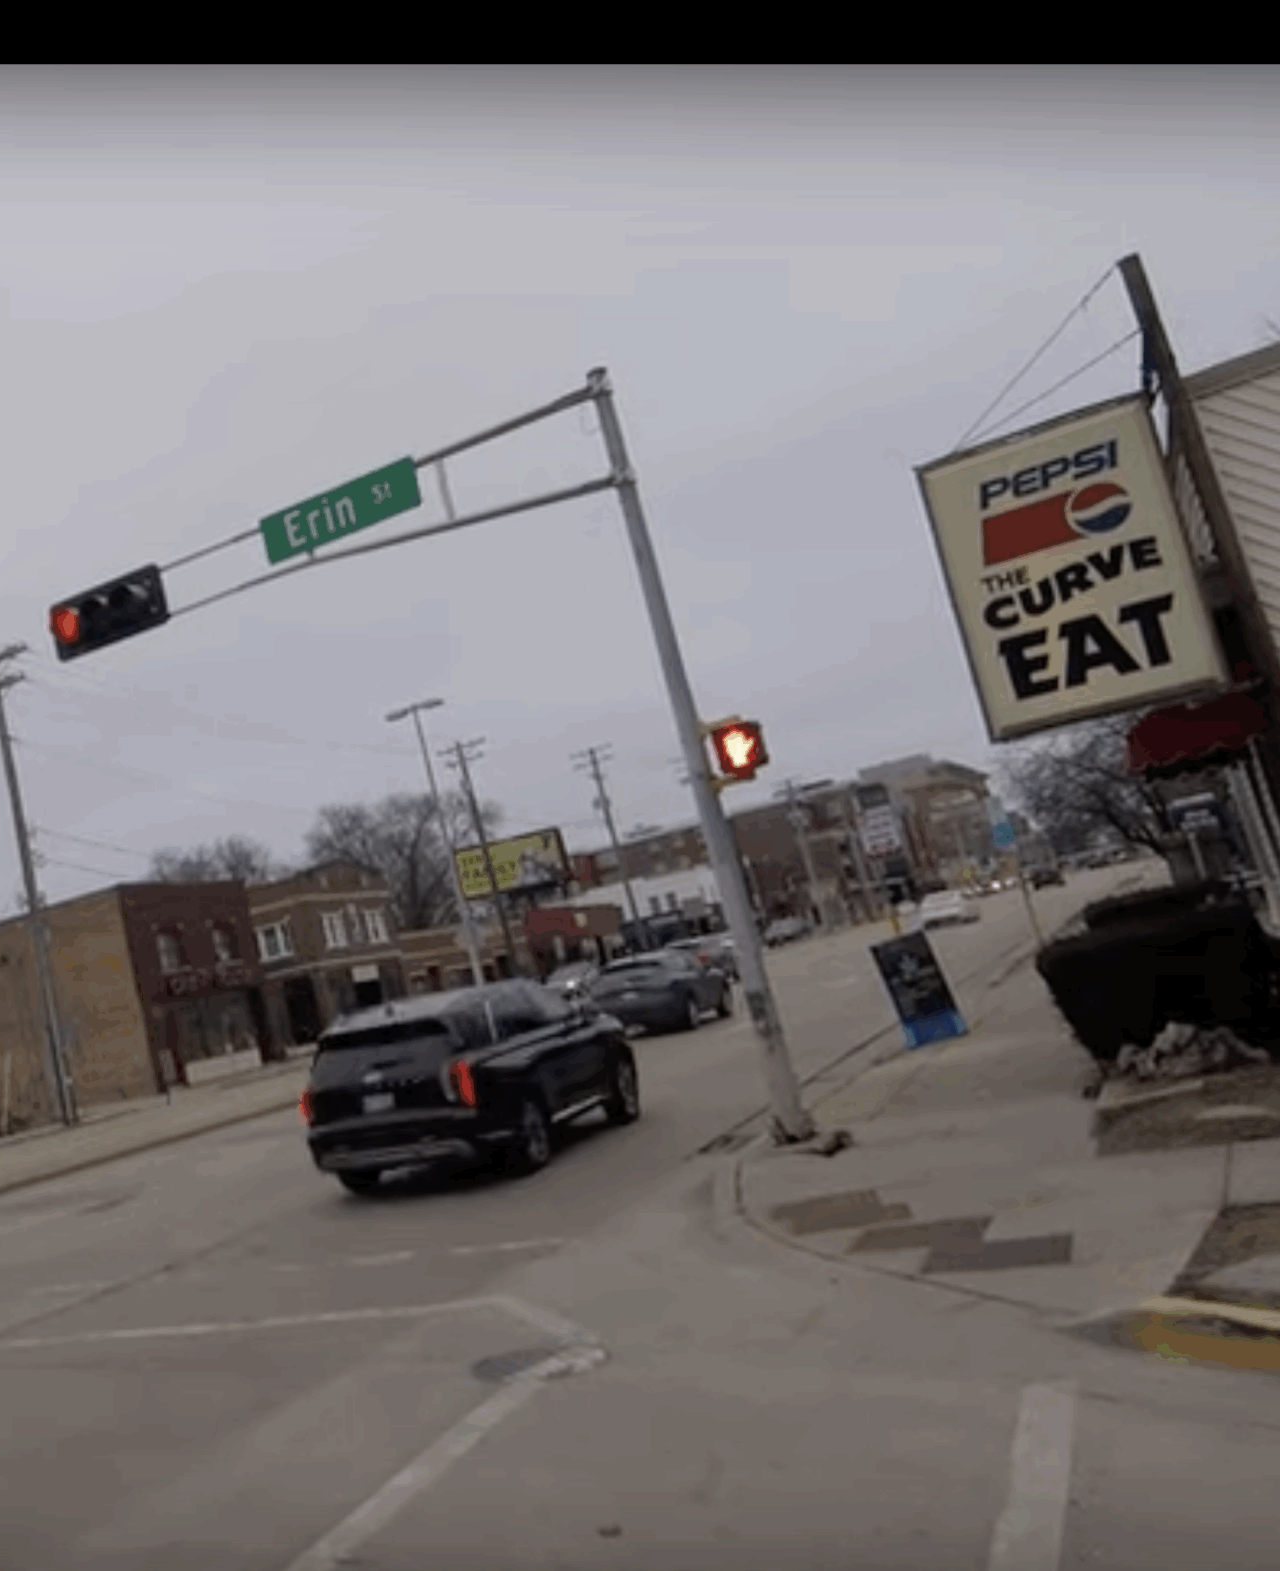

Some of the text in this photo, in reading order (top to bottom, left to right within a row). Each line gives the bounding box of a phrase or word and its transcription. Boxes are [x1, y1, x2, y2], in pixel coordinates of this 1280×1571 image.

[979, 438, 1118, 511] PEPSI
[283, 496, 357, 550] Erin
[981, 566, 1030, 594] THE
[983, 536, 1164, 630] CURVE
[998, 591, 1174, 701] EAT
